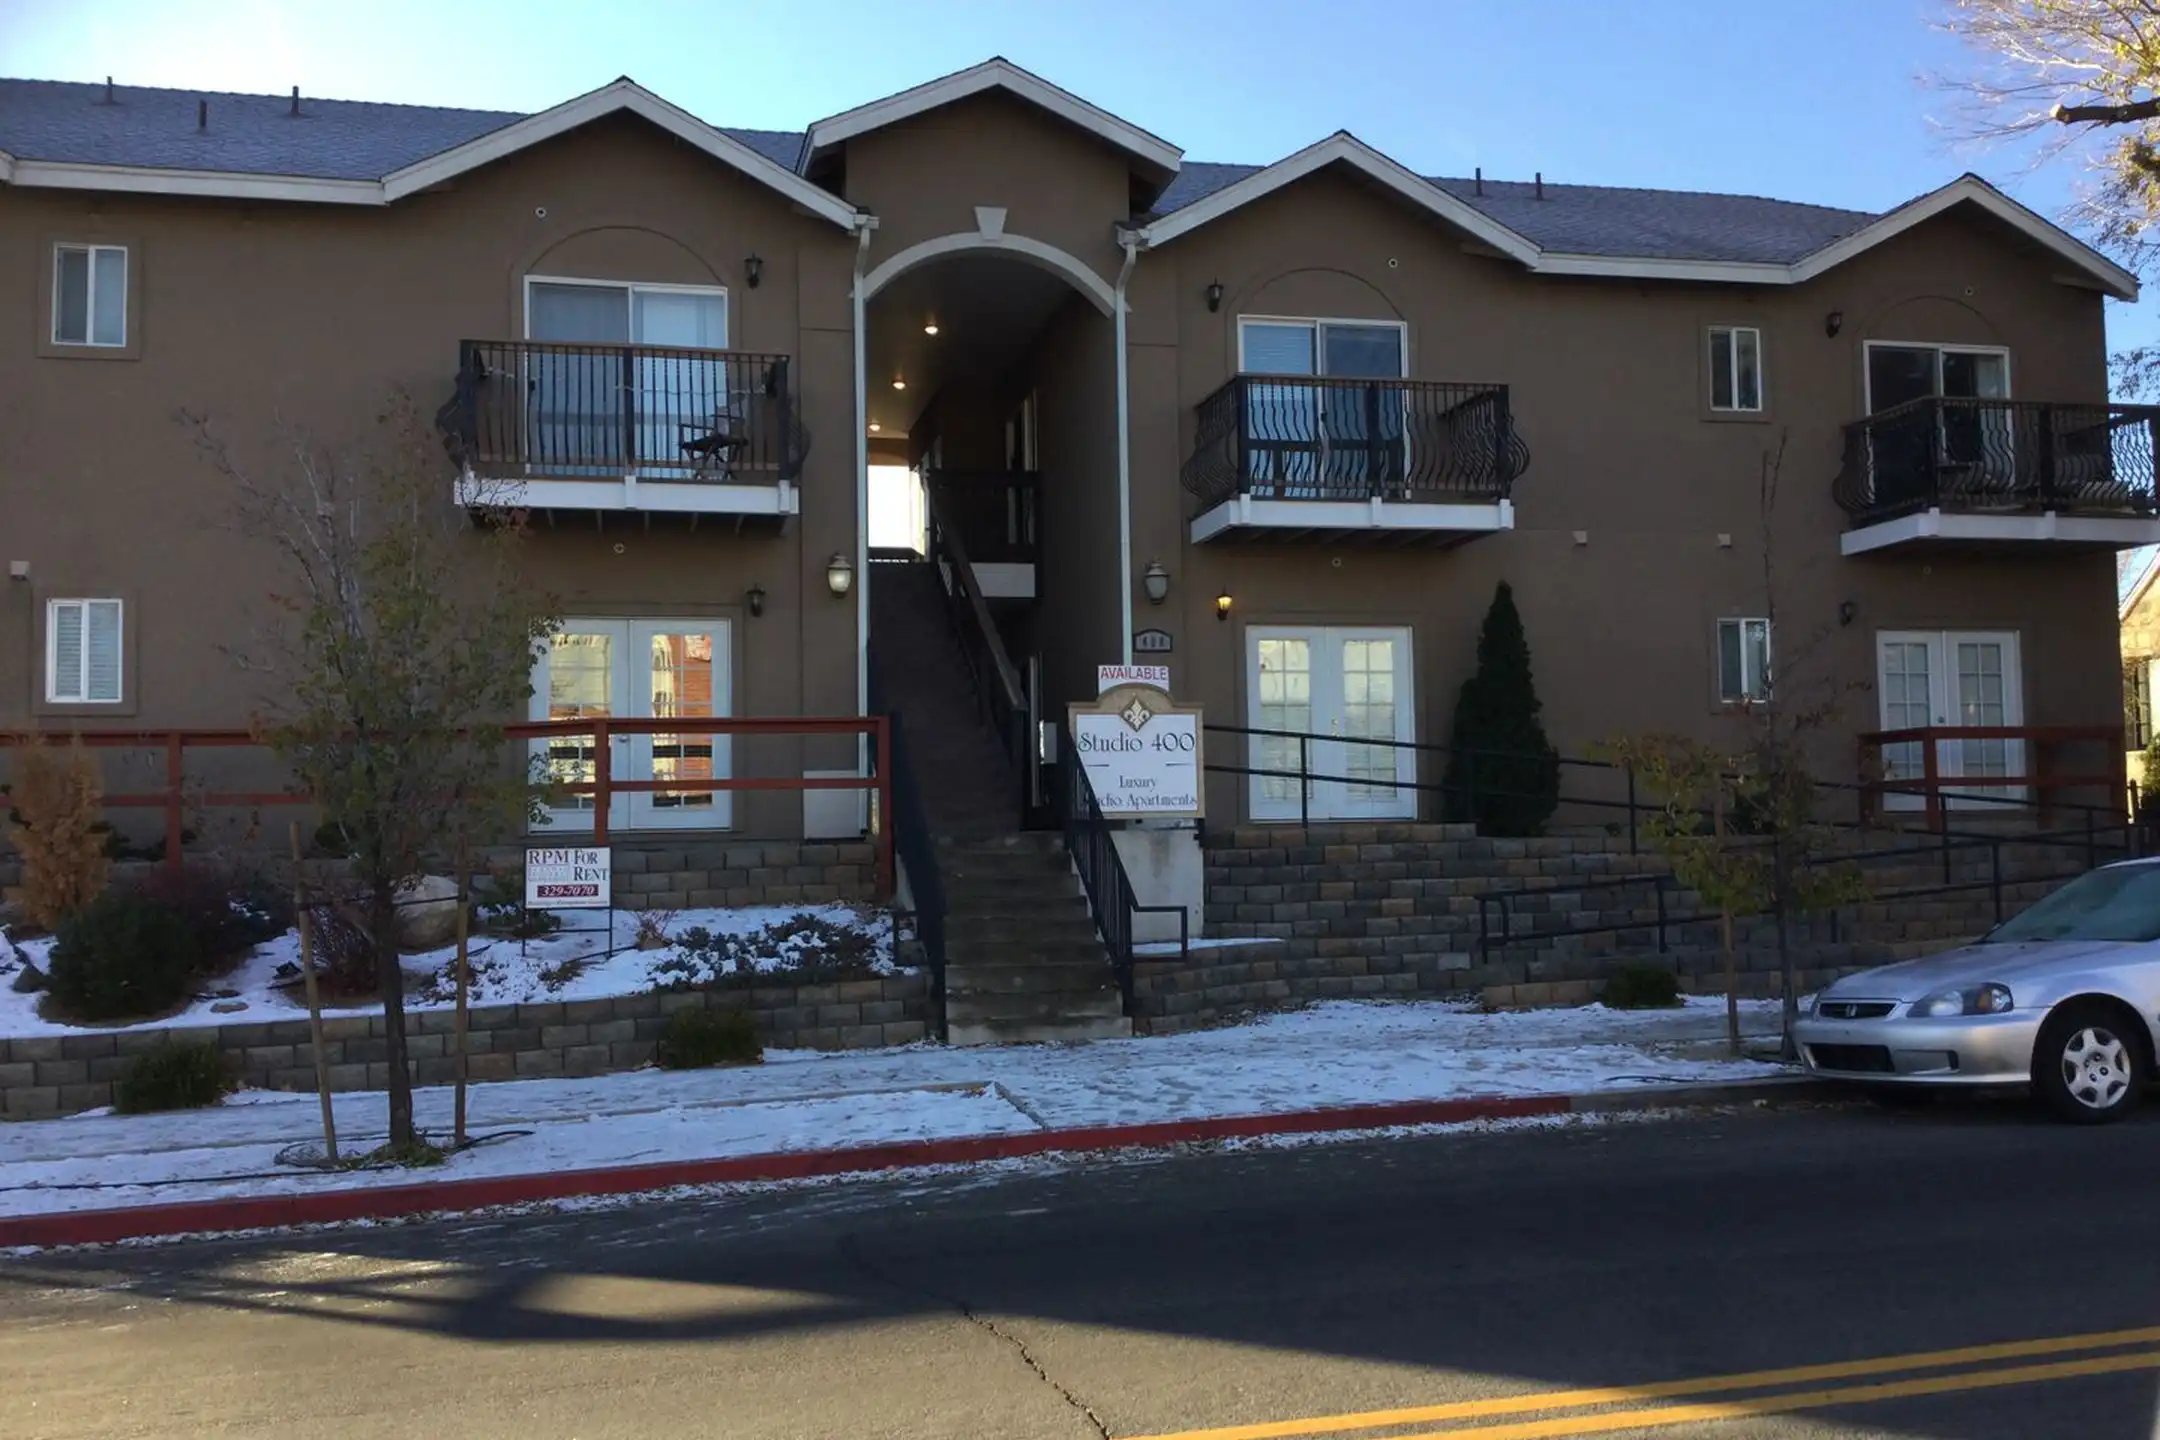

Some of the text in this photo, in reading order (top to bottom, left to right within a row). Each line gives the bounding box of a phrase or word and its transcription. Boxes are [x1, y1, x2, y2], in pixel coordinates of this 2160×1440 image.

[1100, 667, 1167, 681] AVAILABLE
[1078, 732, 1195, 752] Studio 400
[1119, 775, 1157, 793] Luxury
[1127, 793, 1198, 811] Apartments
[529, 850, 569, 865] RPM
[541, 885, 595, 897] 329-7070
